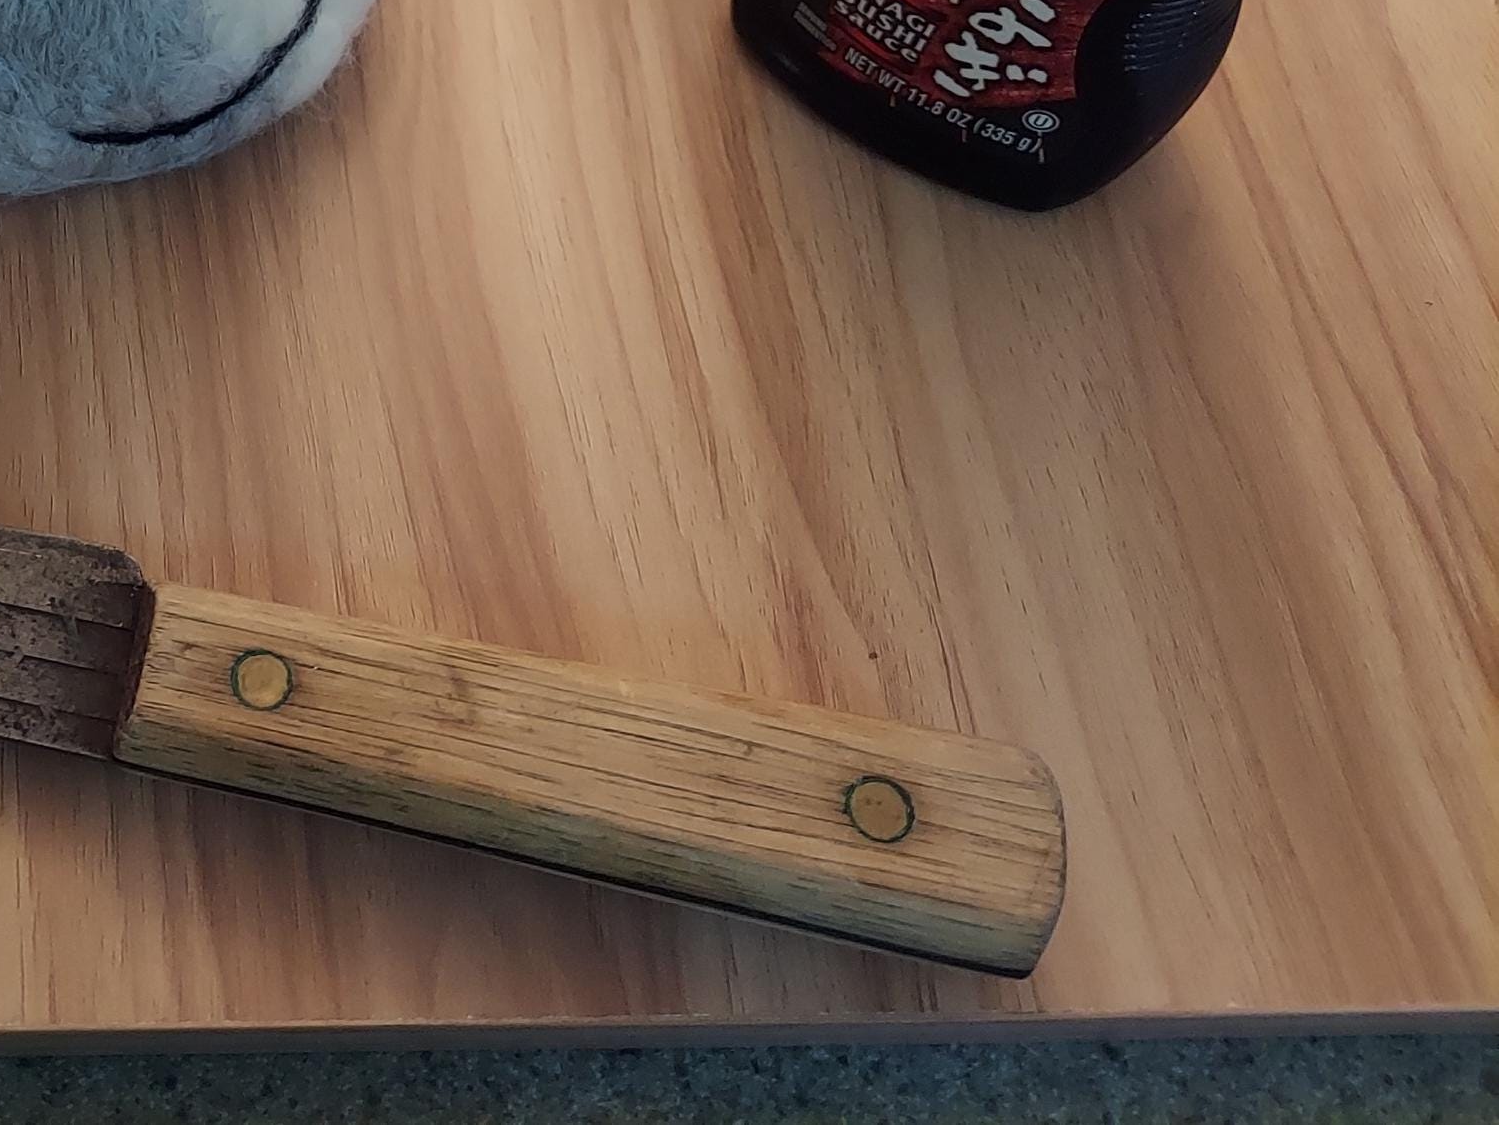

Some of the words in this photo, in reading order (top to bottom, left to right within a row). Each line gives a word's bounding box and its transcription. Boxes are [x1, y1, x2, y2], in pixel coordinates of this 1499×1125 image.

[844, 47, 878, 75] NET
[877, 69, 906, 93] WT
[907, 88, 946, 115] 11.8
[946, 108, 974, 128] OZ
[973, 117, 1017, 145] (335
